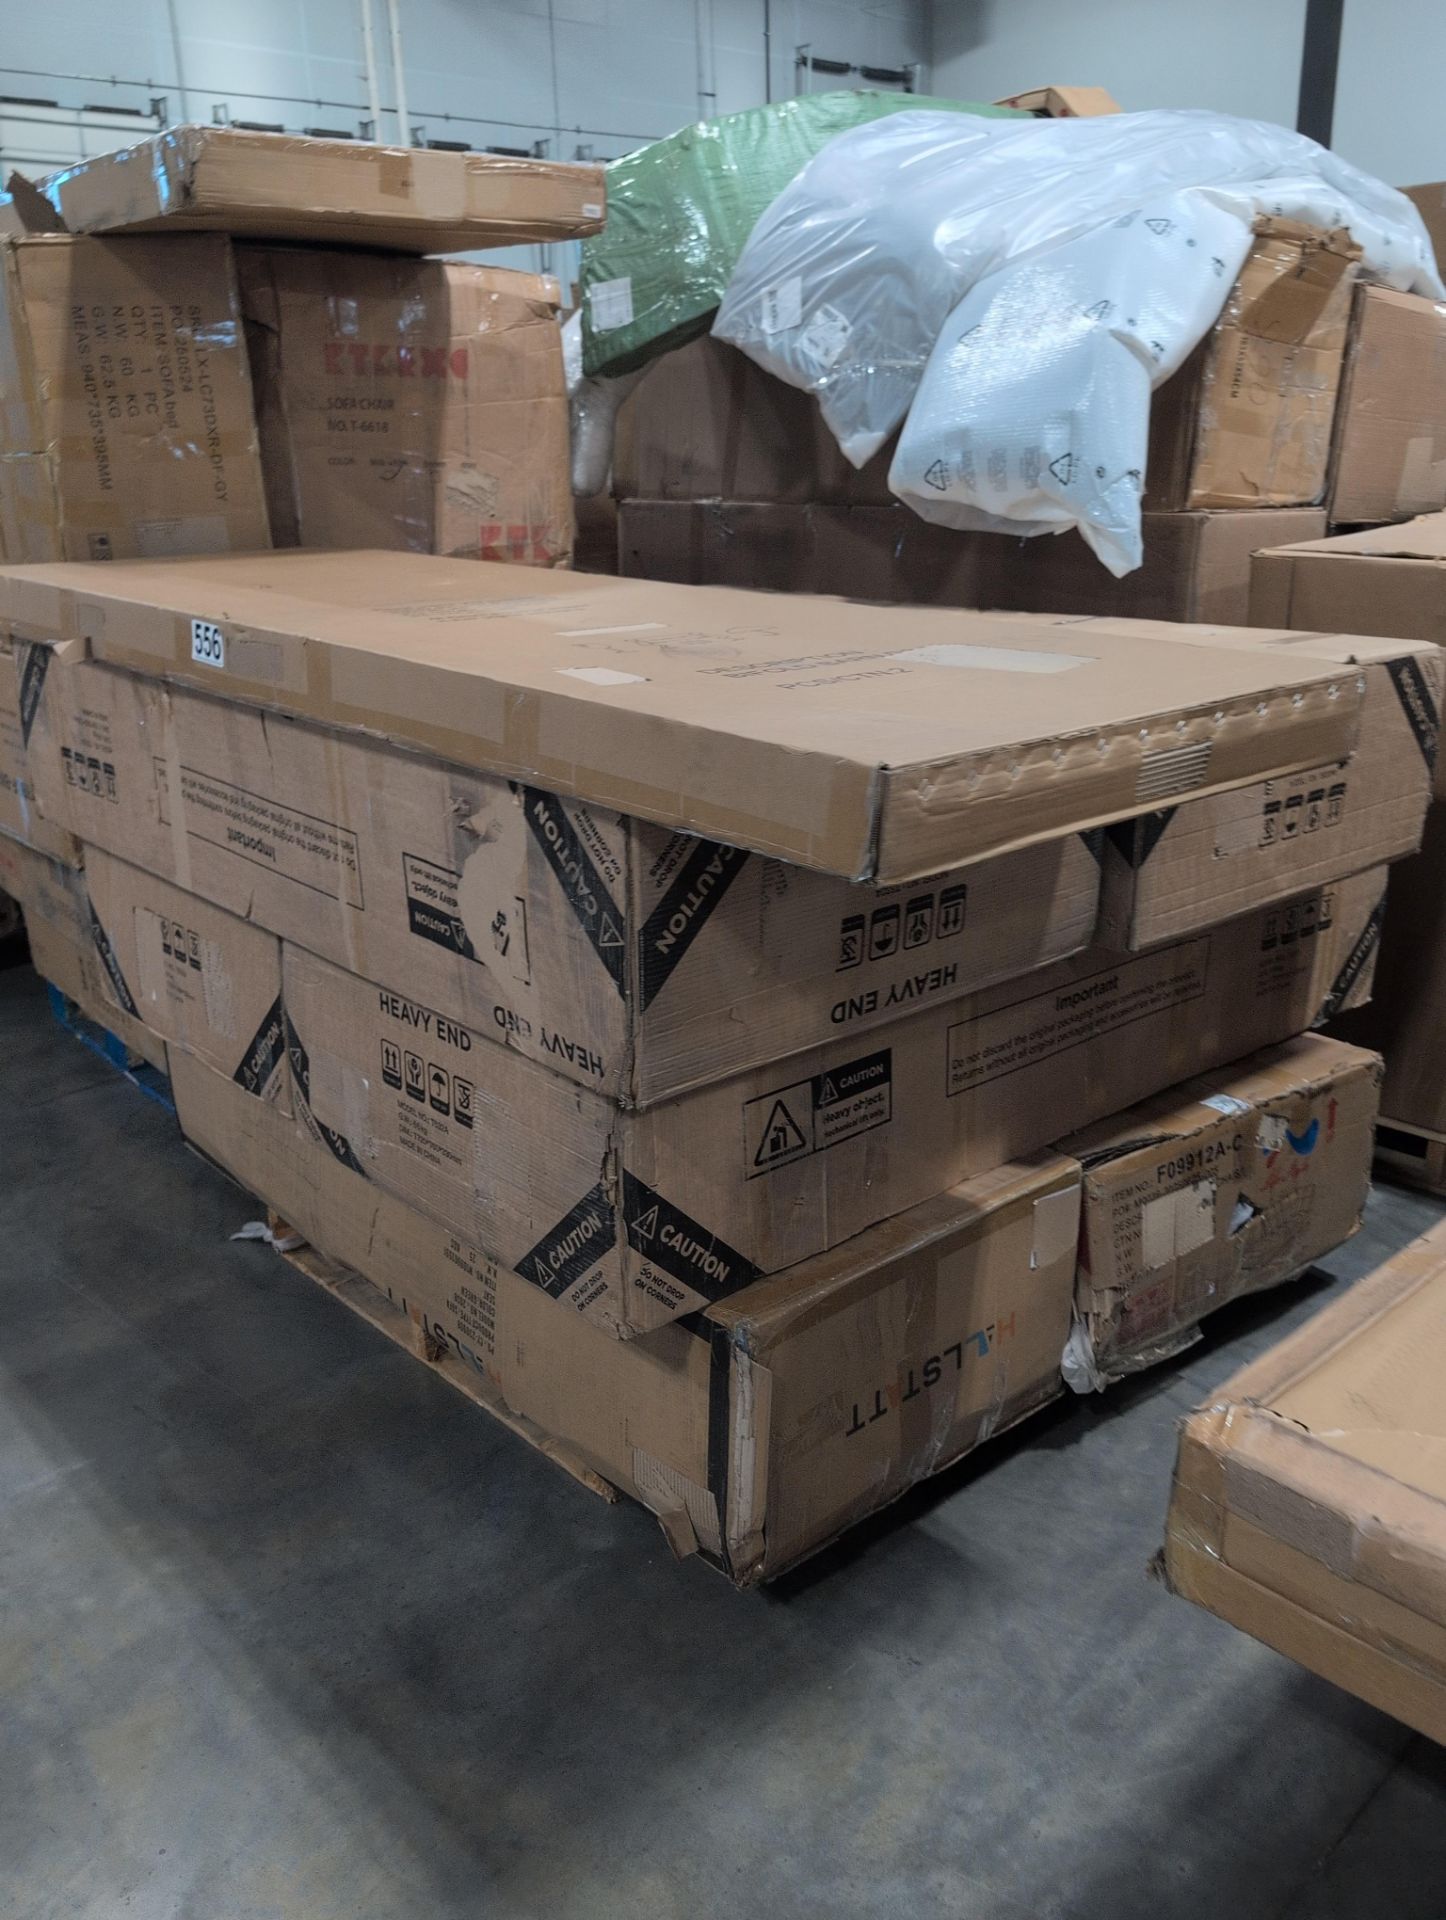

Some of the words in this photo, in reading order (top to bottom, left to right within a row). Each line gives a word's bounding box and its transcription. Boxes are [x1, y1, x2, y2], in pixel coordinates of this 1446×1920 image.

[121, 357, 134, 377] 60
[107, 395, 121, 419] KG
[126, 394, 140, 418] KG
[143, 391, 160, 415] PC
[327, 396, 357, 410] SOFA
[360, 398, 395, 411] CHAIR
[193, 622, 222, 661] 556
[227, 828, 276, 863] Important
[534, 800, 599, 916] CAUTION
[591, 843, 607, 866] NOT
[655, 843, 738, 956] CAUTION
[415, 911, 451, 937] CAUTION
[884, 963, 958, 1008] HEAVY
[1055, 976, 1120, 1012] Important
[379, 992, 431, 1034] HEAVY
[436, 1022, 472, 1053] END
[831, 990, 878, 1024] END
[252, 1021, 281, 1075] CAUTION
[540, 1027, 605, 1078] HEAVY
[840, 1063, 884, 1089] CAUTION
[822, 1105, 852, 1125] Heavy
[1157, 1133, 1244, 1184] F09912A-C
[549, 1210, 603, 1270] CAUTION
[659, 1224, 731, 1284] CAUTION
[484, 1275, 497, 1292] ITEM
[570, 1290, 581, 1303] DO
[579, 1280, 592, 1296] NOT
[588, 1269, 605, 1287] DROP
[576, 1301, 586, 1313] ON
[583, 1284, 609, 1309] CORNERS
[634, 1278, 646, 1290] ON
[644, 1285, 678, 1311] CORNERS
[651, 1274, 667, 1289] NOT
[664, 1283, 686, 1301] DROP
[472, 1321, 496, 1343] PRODUCT
[479, 1311, 496, 1330] MODEL
